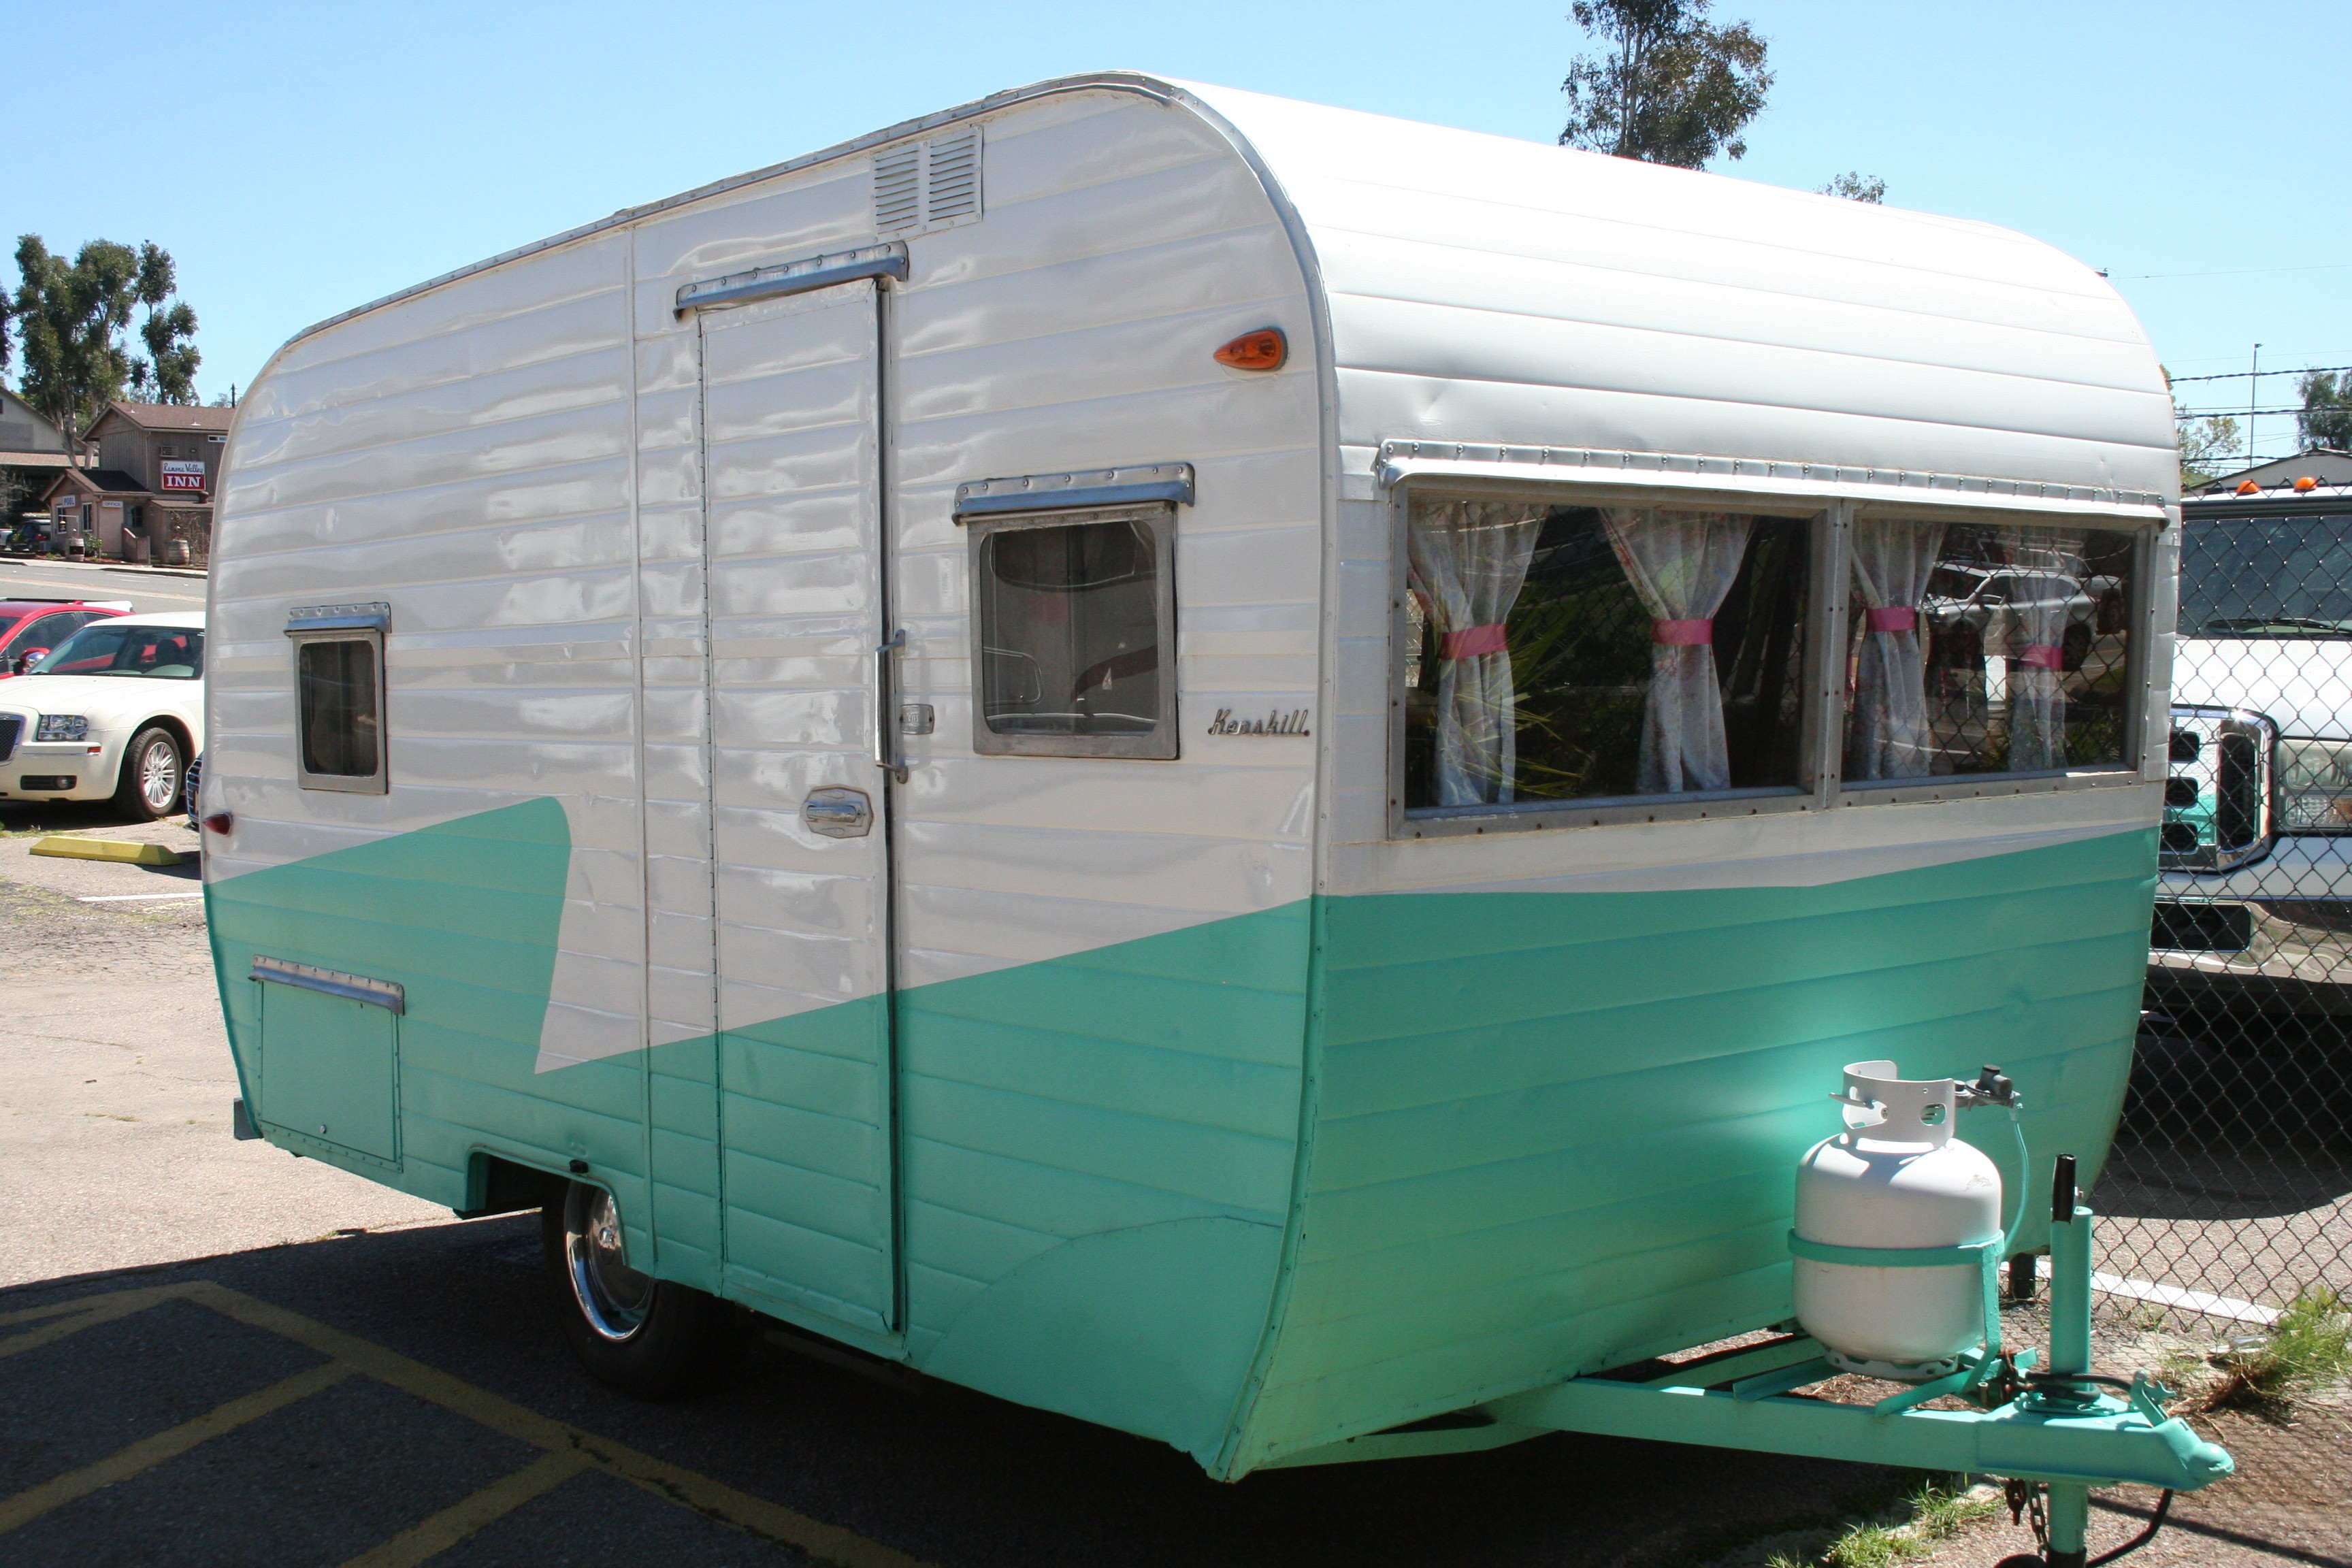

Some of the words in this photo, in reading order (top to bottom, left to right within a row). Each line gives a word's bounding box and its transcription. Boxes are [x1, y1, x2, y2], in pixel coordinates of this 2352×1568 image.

[163, 463, 185, 472] Ramona
[185, 463, 203, 473] Valley
[167, 476, 201, 487] INN
[64, 497, 74, 506] POOL
[1209, 708, 1309, 736] Kenskill
